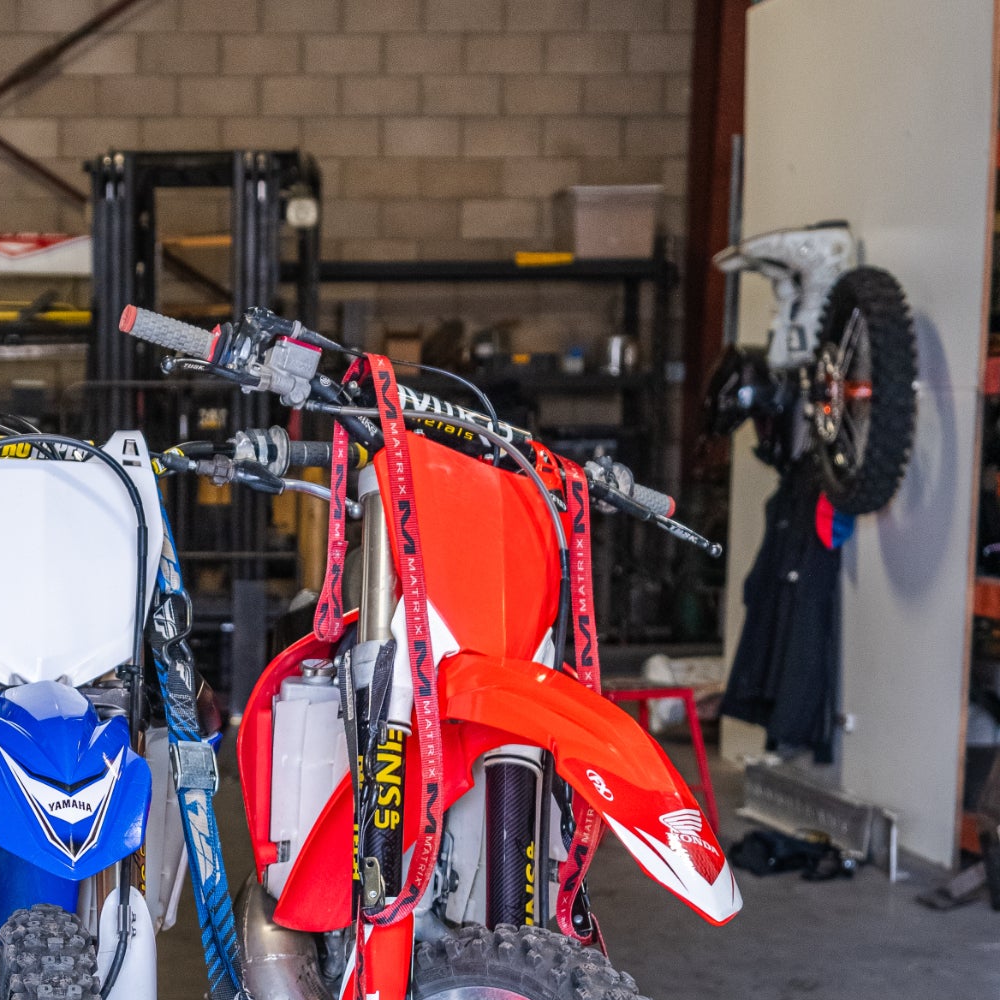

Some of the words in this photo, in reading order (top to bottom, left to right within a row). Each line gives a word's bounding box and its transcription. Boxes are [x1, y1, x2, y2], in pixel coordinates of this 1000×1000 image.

[389, 423, 407, 495] MATRIX
[408, 558, 423, 635] MATRIX
[576, 538, 587, 612] MATRIX
[421, 700, 437, 777] MATRIX
[48, 799, 92, 812] YAMAHA
[374, 809, 400, 829] UP
